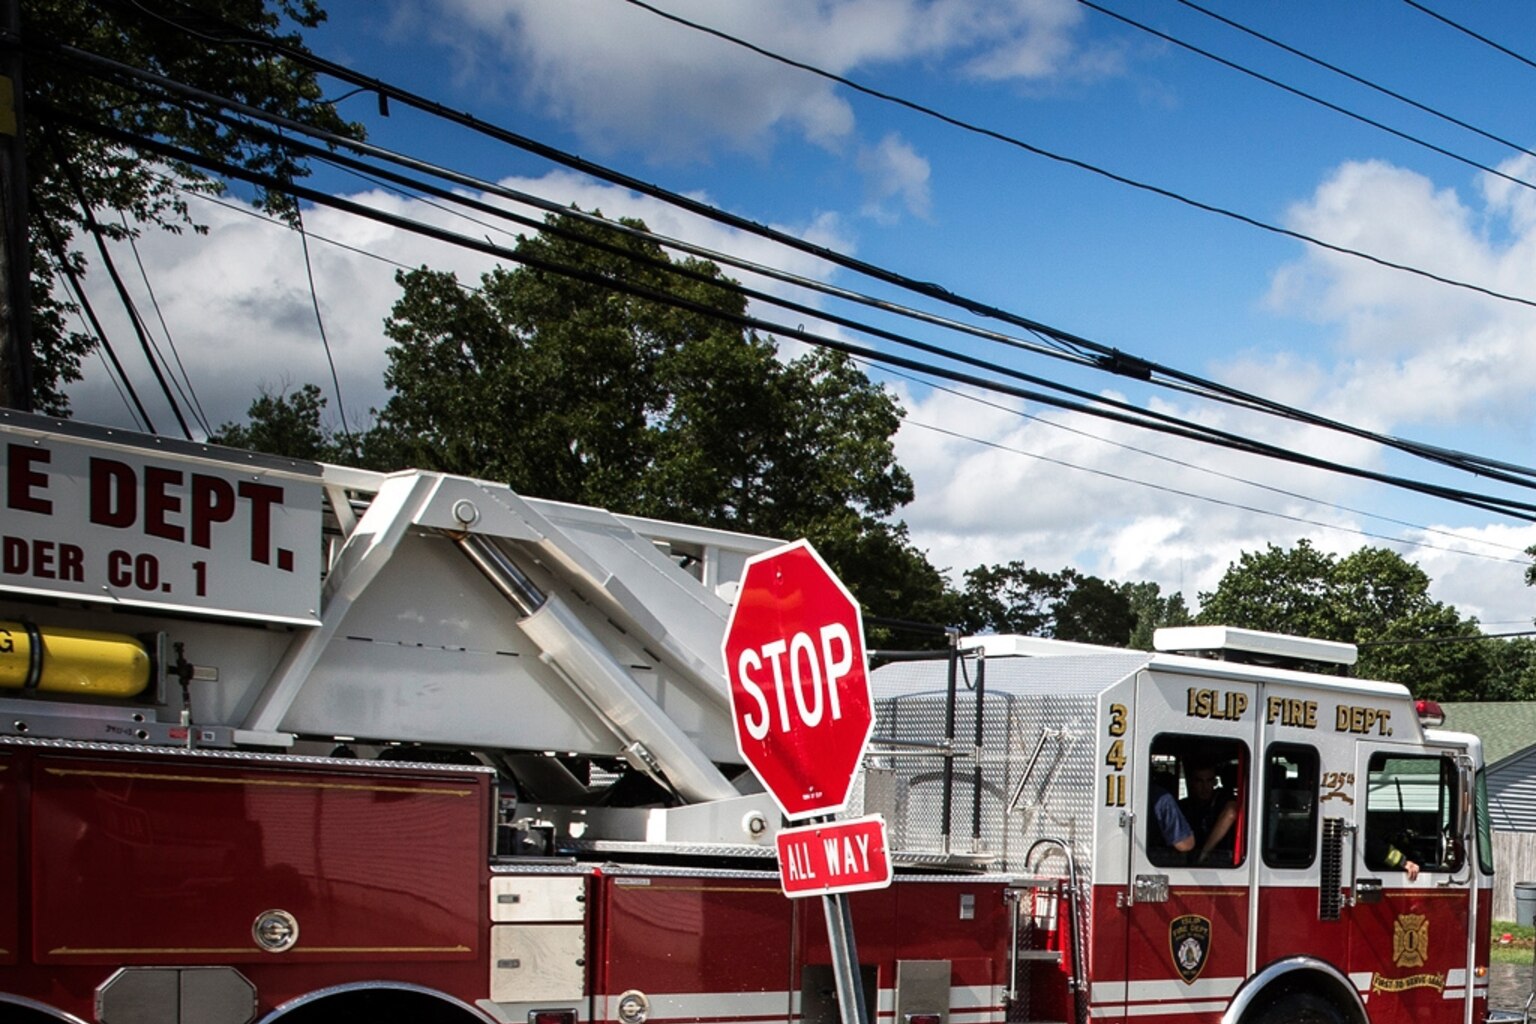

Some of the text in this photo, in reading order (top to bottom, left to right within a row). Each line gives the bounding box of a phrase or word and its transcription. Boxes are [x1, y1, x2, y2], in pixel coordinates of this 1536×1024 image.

[7, 443, 294, 573] E DEPT.
[2, 535, 207, 597] DER CO. 1
[738, 622, 852, 741] STOP
[1187, 687, 1394, 736] ISLIP FIRE DEPT.
[787, 833, 870, 882] ALL WAY
